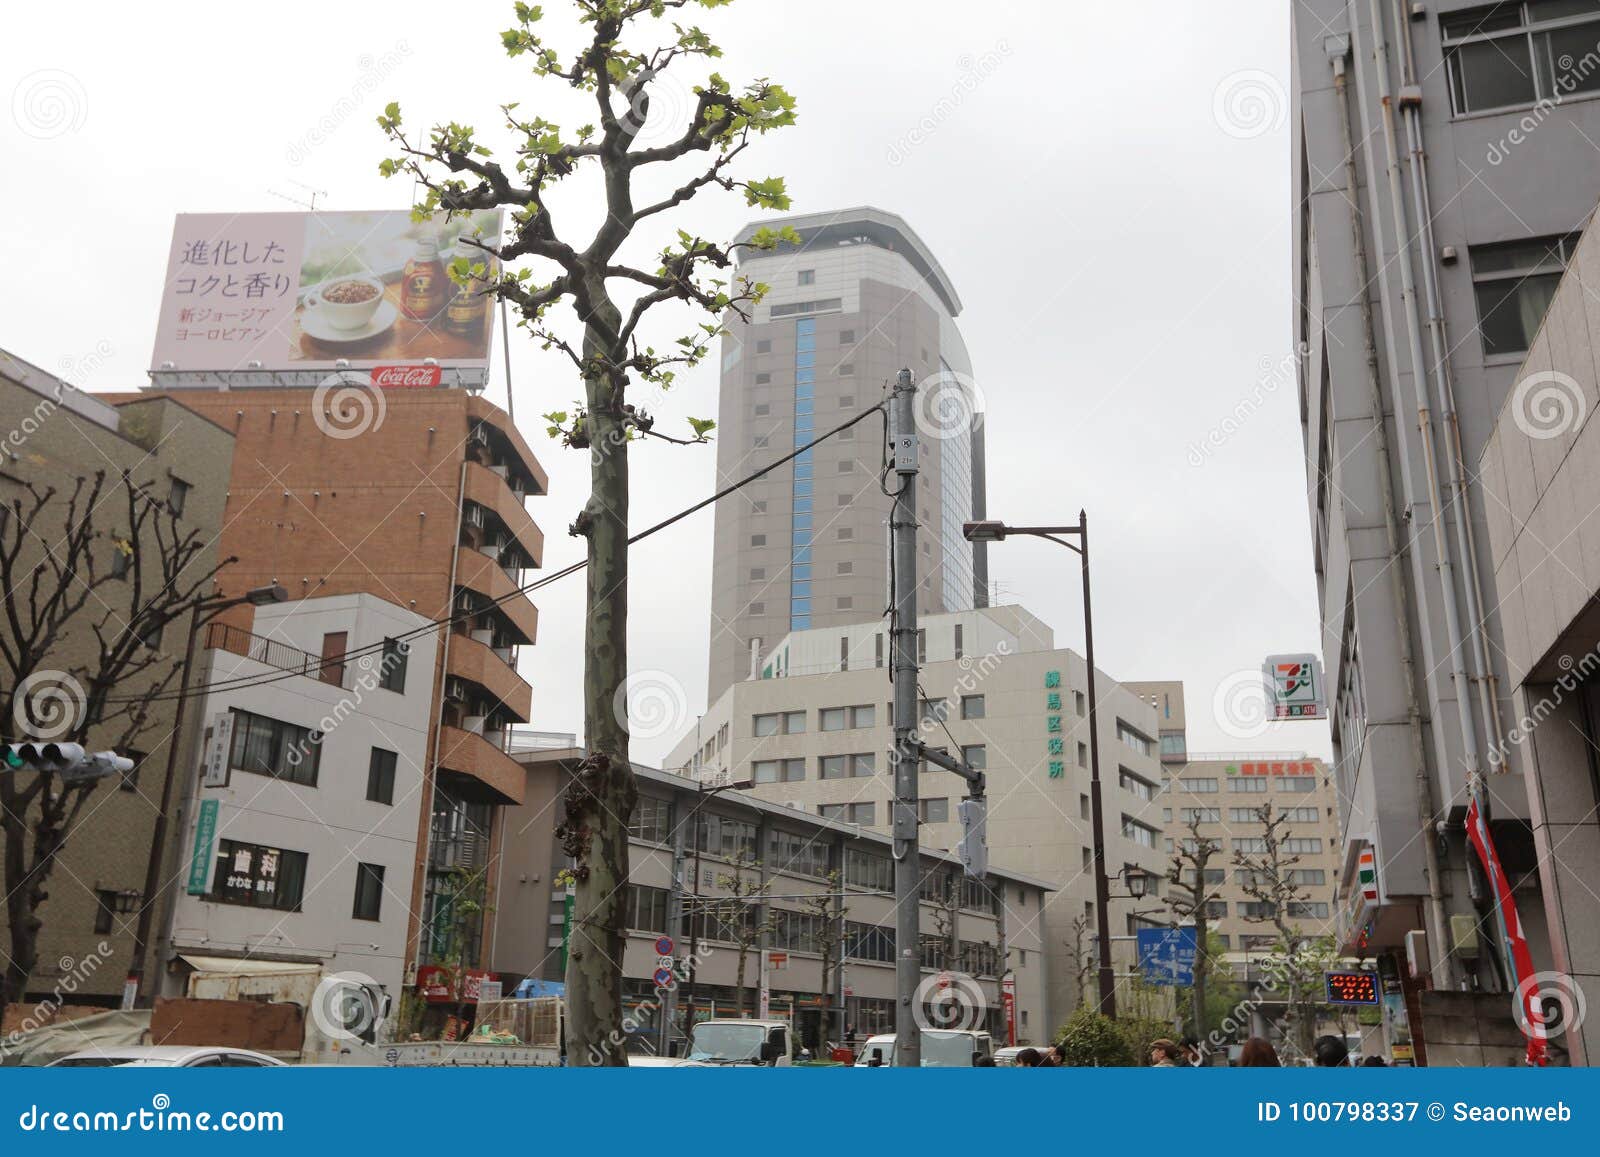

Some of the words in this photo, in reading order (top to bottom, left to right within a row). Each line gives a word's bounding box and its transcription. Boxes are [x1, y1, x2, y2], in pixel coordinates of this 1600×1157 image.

[181, 239, 285, 266] 進化した
[175, 271, 291, 298] コクと香り
[179, 308, 272, 323] 新ジョージア
[1045, 671, 1064, 779] 練馬区役所
